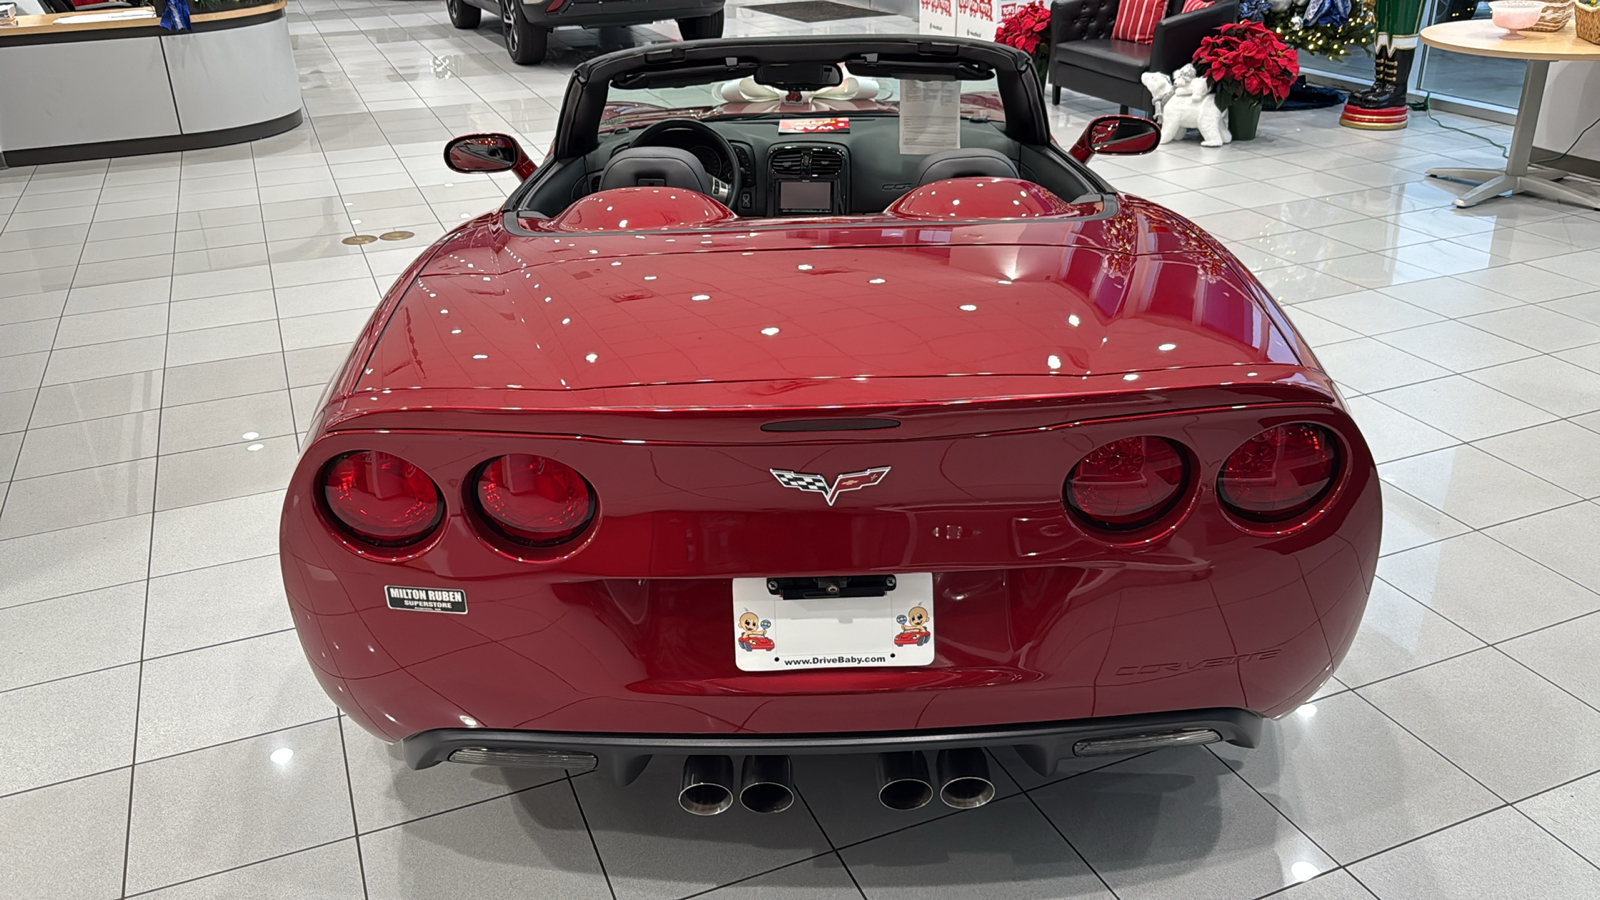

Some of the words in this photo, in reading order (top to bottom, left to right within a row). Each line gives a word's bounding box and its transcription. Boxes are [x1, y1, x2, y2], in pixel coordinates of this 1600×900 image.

[390, 588, 426, 600] MILTON
[427, 591, 462, 602] RUBEN
[404, 600, 452, 608] SUPERSTORE
[784, 655, 886, 665] www.DriveBaby.com
[1115, 648, 1281, 676] CORVETTE
